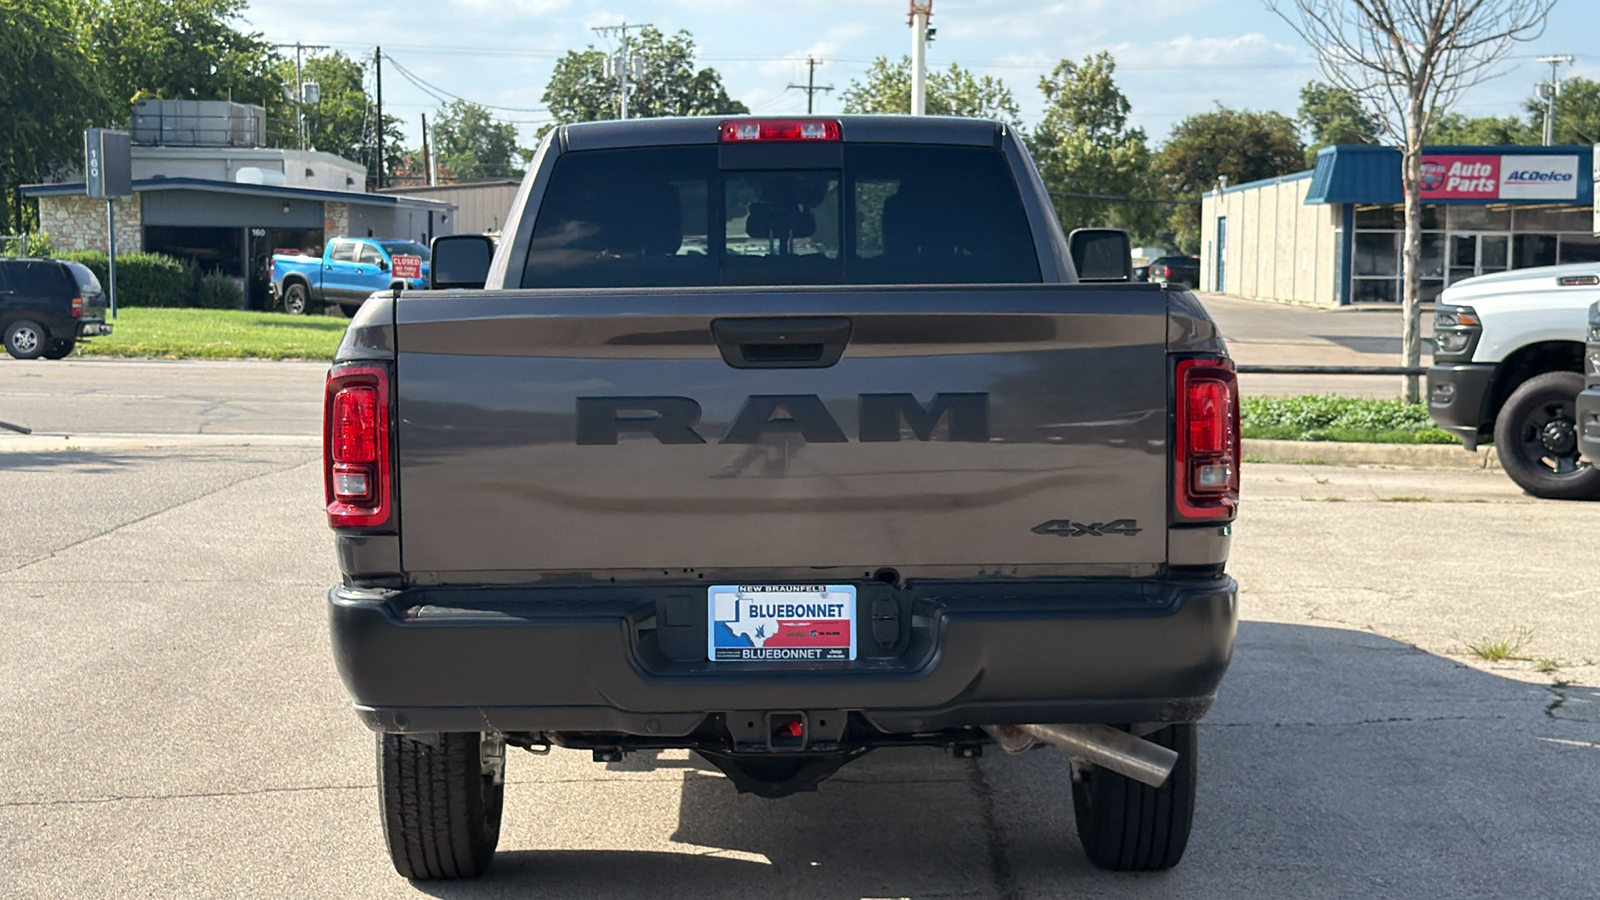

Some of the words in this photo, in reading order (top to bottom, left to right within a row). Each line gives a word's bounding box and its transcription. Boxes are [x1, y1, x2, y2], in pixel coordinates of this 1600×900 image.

[1448, 161, 1492, 176] Auto
[1507, 170, 1573, 182] ACDelco
[1446, 178, 1495, 193] Parts
[252, 228, 266, 237] 160
[576, 392, 990, 445] RAM
[1030, 519, 1143, 537] 4x4
[749, 604, 844, 618] BLUEBONNET
[742, 649, 822, 659] BLUEBONNET
